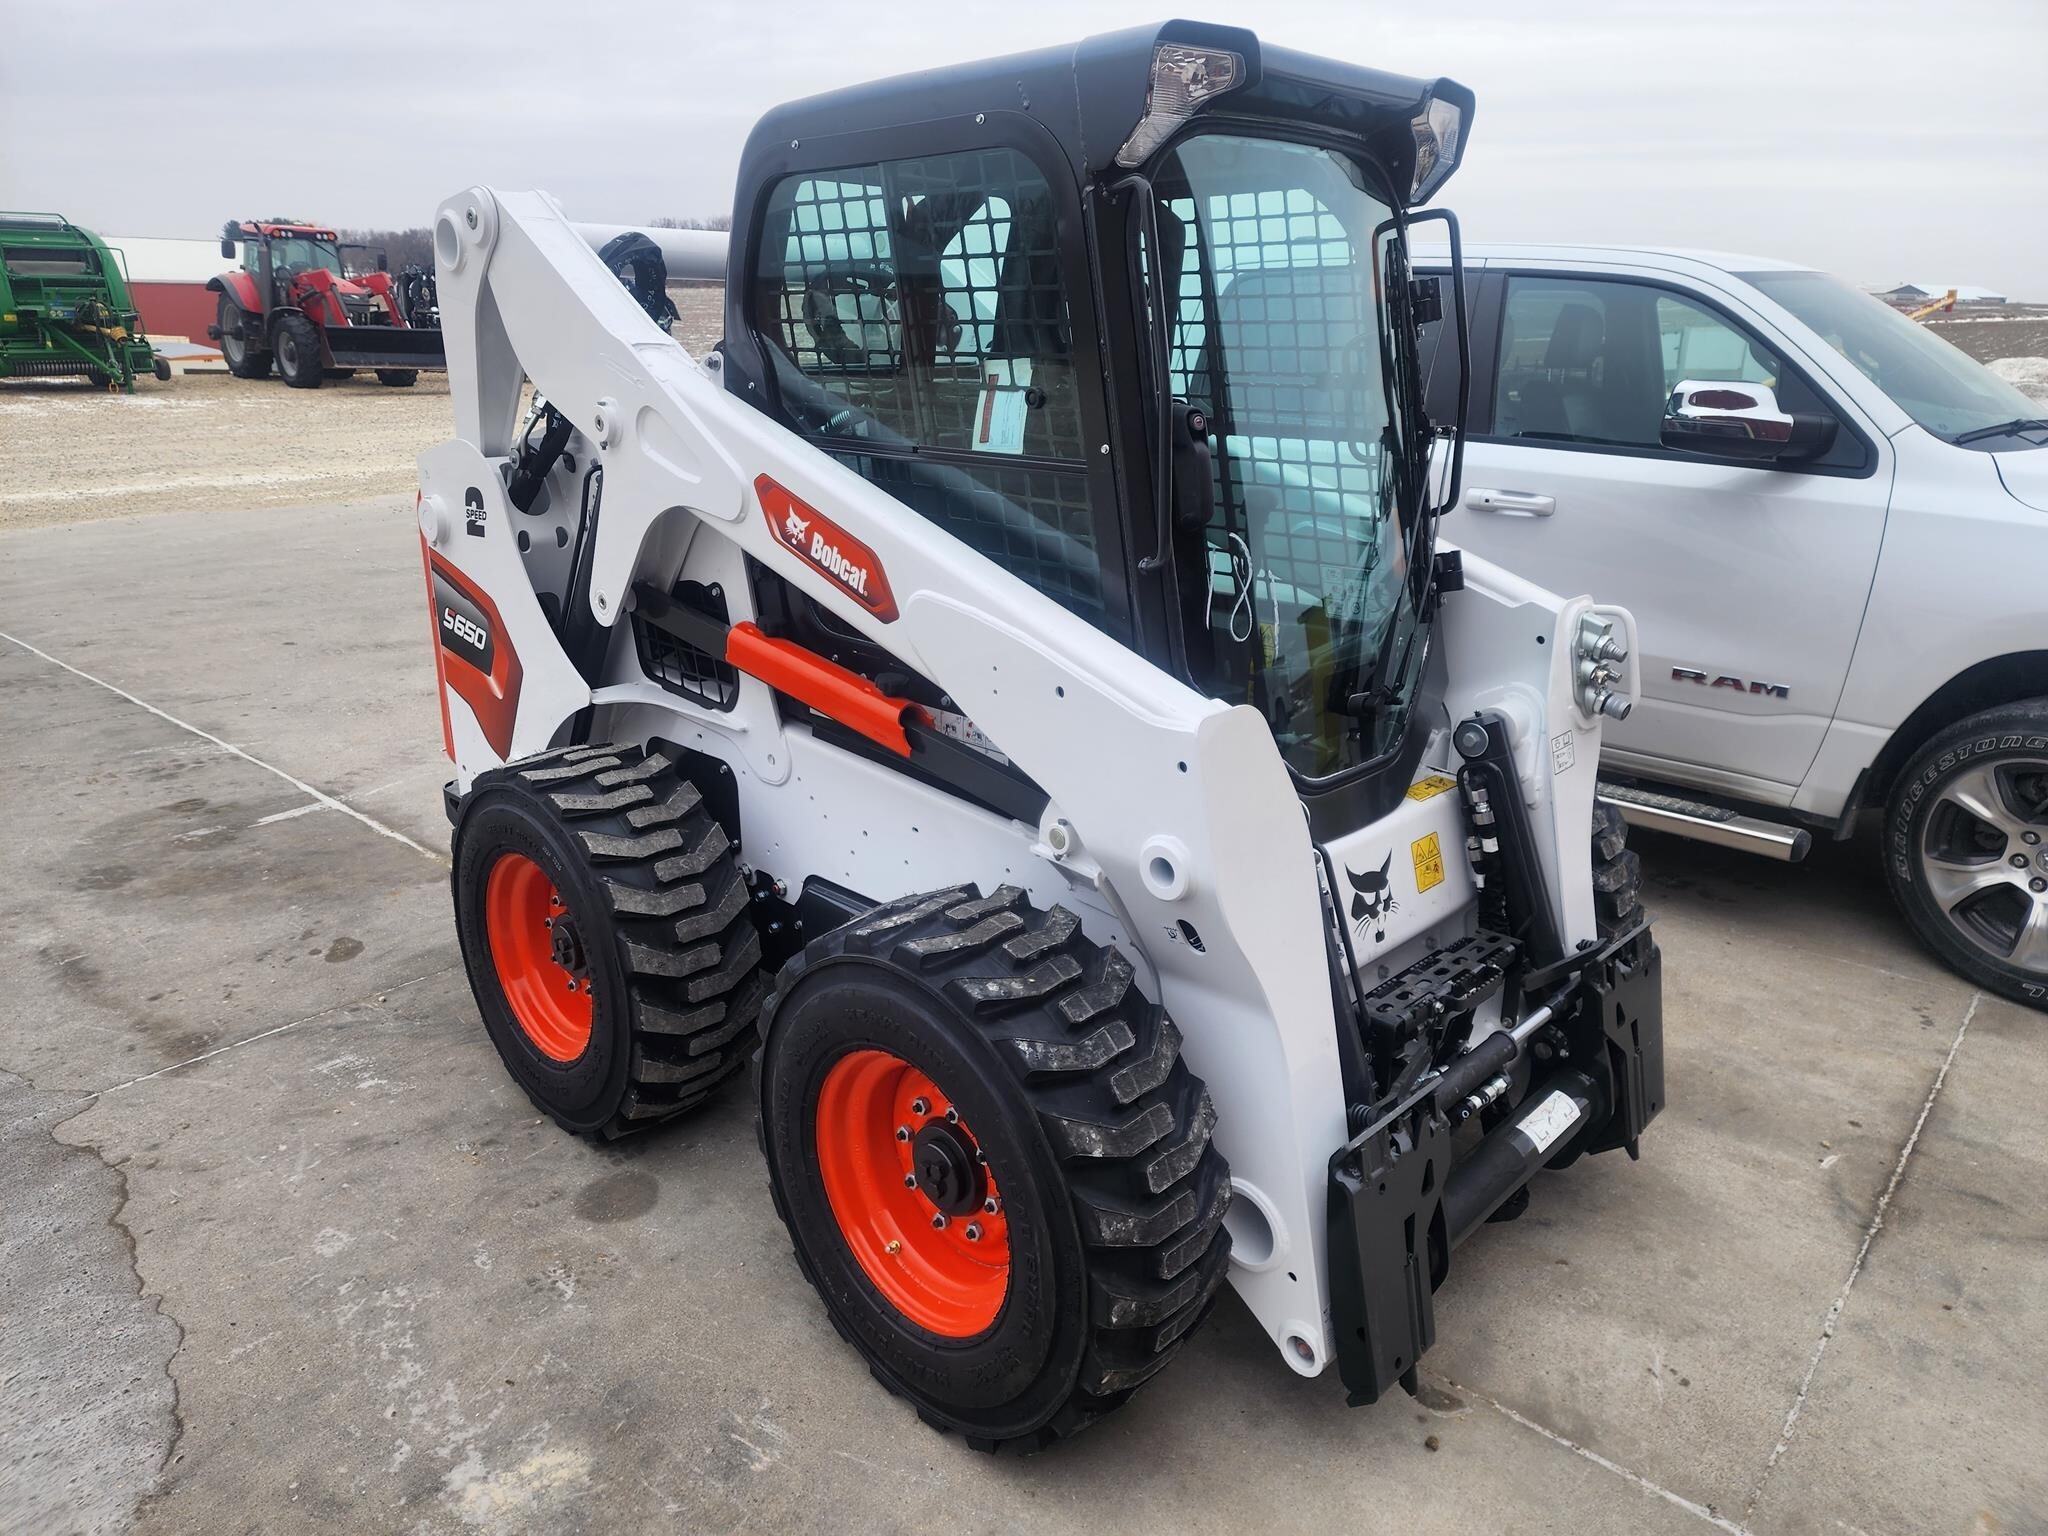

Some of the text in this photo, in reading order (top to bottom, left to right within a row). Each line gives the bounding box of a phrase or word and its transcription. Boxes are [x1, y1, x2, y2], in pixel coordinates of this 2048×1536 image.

[465, 486, 485, 538] 2
[465, 508, 487, 520] SPEED
[810, 531, 867, 594] Bobcat
[443, 607, 487, 650] S650
[1671, 665, 1790, 699] RAM
